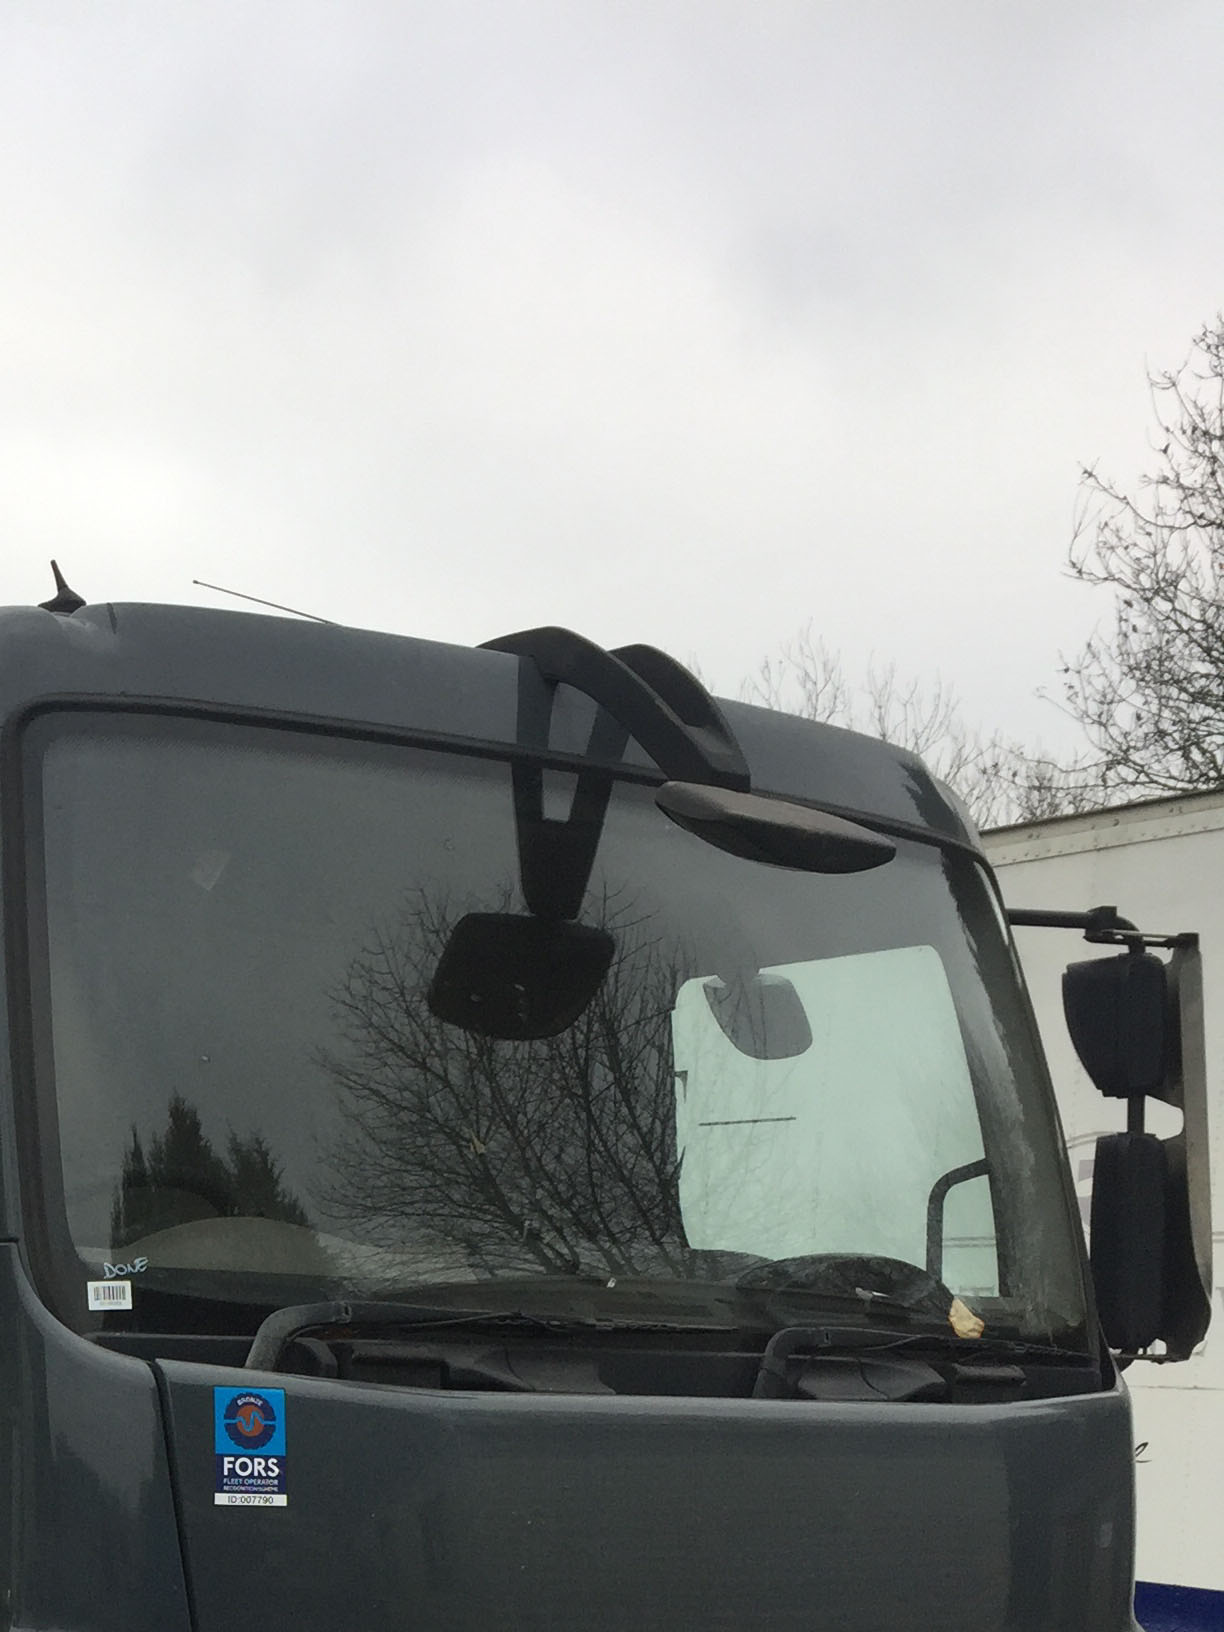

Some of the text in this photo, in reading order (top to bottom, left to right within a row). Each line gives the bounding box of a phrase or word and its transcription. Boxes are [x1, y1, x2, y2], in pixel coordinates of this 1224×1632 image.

[103, 1256, 149, 1280] DONE
[223, 1456, 280, 1477] FORS
[223, 1477, 279, 1486] FLEET OPERATOR
